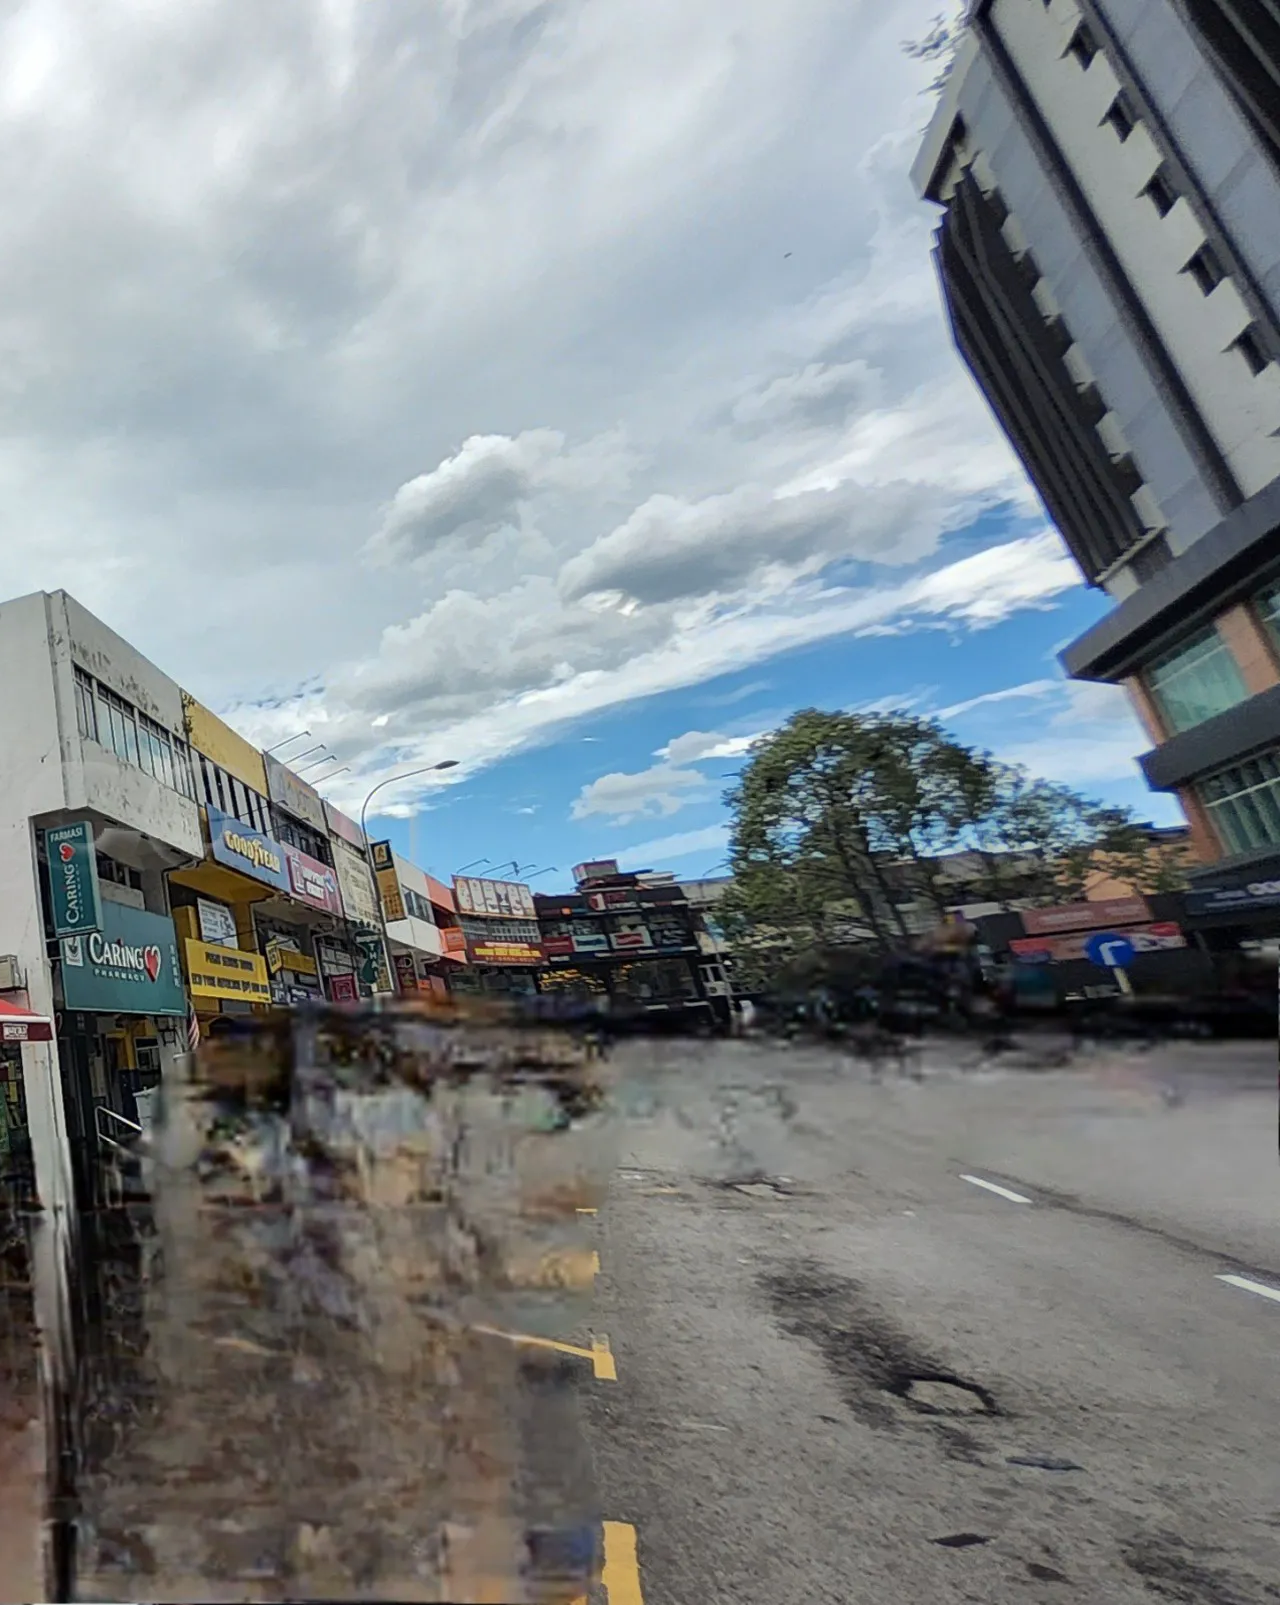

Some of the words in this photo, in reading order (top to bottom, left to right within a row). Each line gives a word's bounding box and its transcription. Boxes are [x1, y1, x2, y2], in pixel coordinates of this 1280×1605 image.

[50, 828, 83, 842] FARMASI
[224, 830, 281, 874] GOODYEAR
[64, 864, 80, 924] CARING
[89, 933, 145, 970] CARING
[95, 968, 145, 982] PHARMACY
